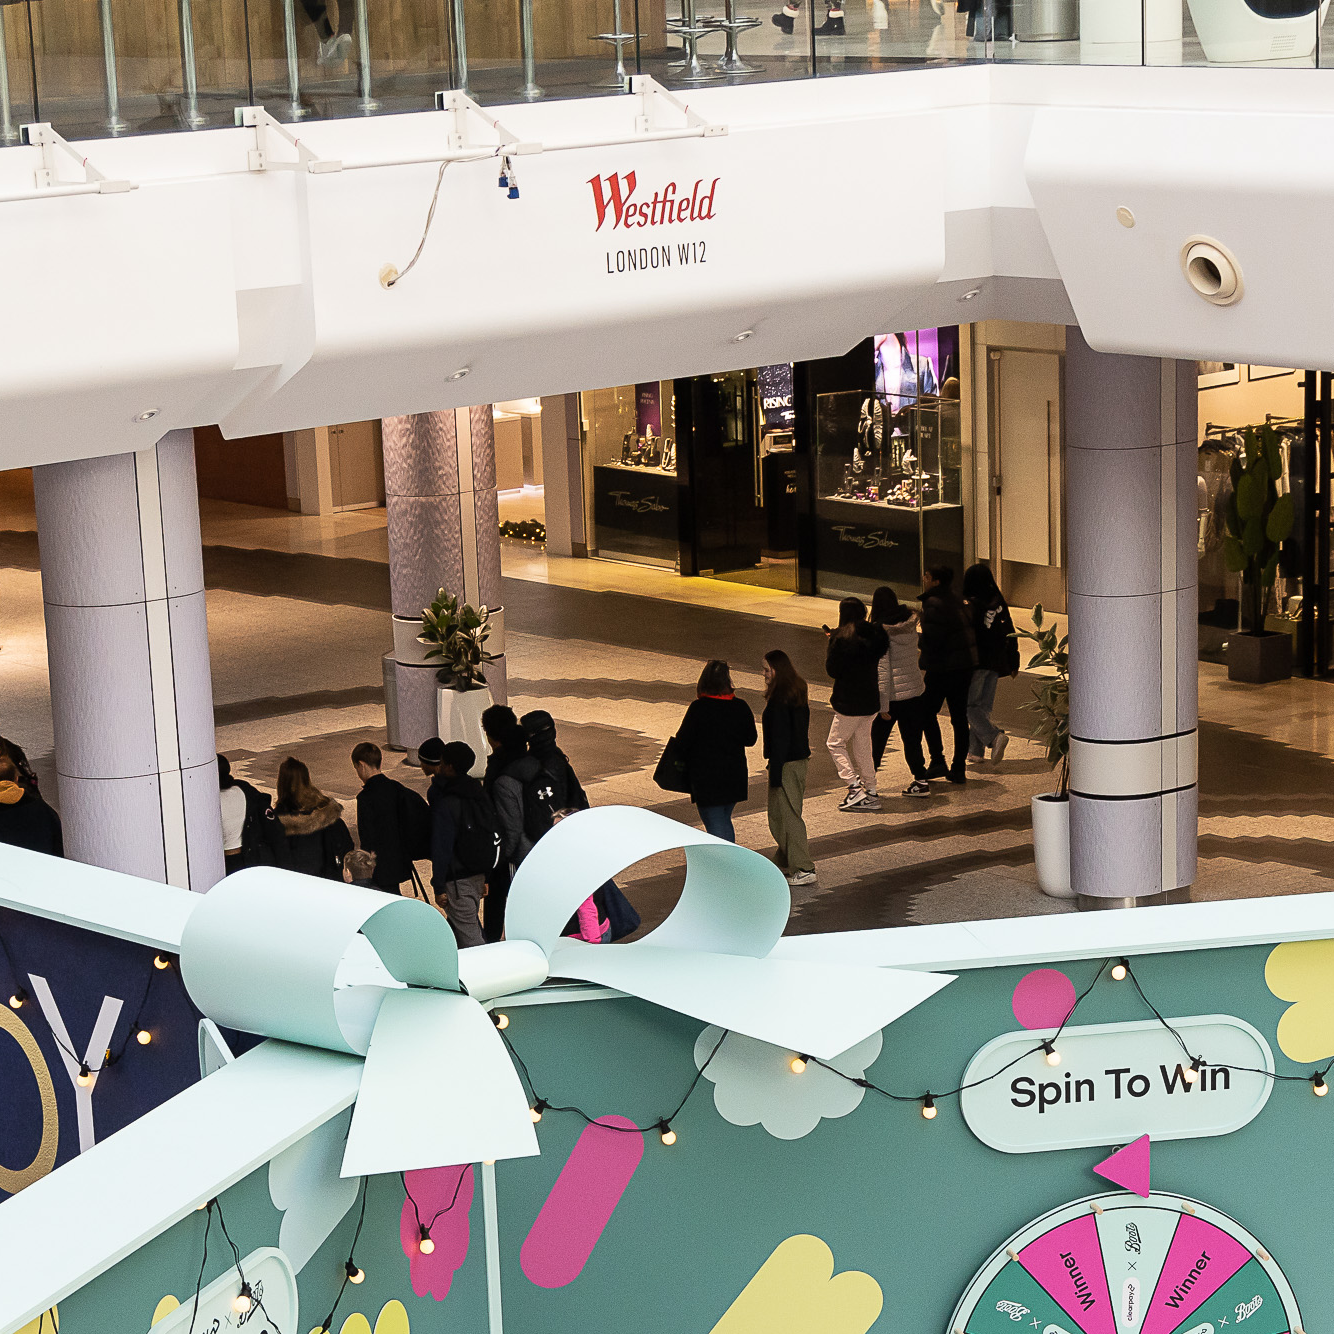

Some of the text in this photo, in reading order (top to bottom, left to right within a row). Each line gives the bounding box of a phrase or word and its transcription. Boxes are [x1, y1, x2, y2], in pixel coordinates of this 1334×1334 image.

[586, 170, 721, 232] Westfield
[607, 241, 706, 273] LONDON W12
[1011, 1064, 1230, 1113] Spin To Win
[1125, 1222, 1141, 1254] Boots
[1060, 1252, 1096, 1311] Winner
[1165, 1251, 1212, 1309] Winner
[996, 1300, 1030, 1321] Boots
[1235, 1295, 1263, 1324] Boots
